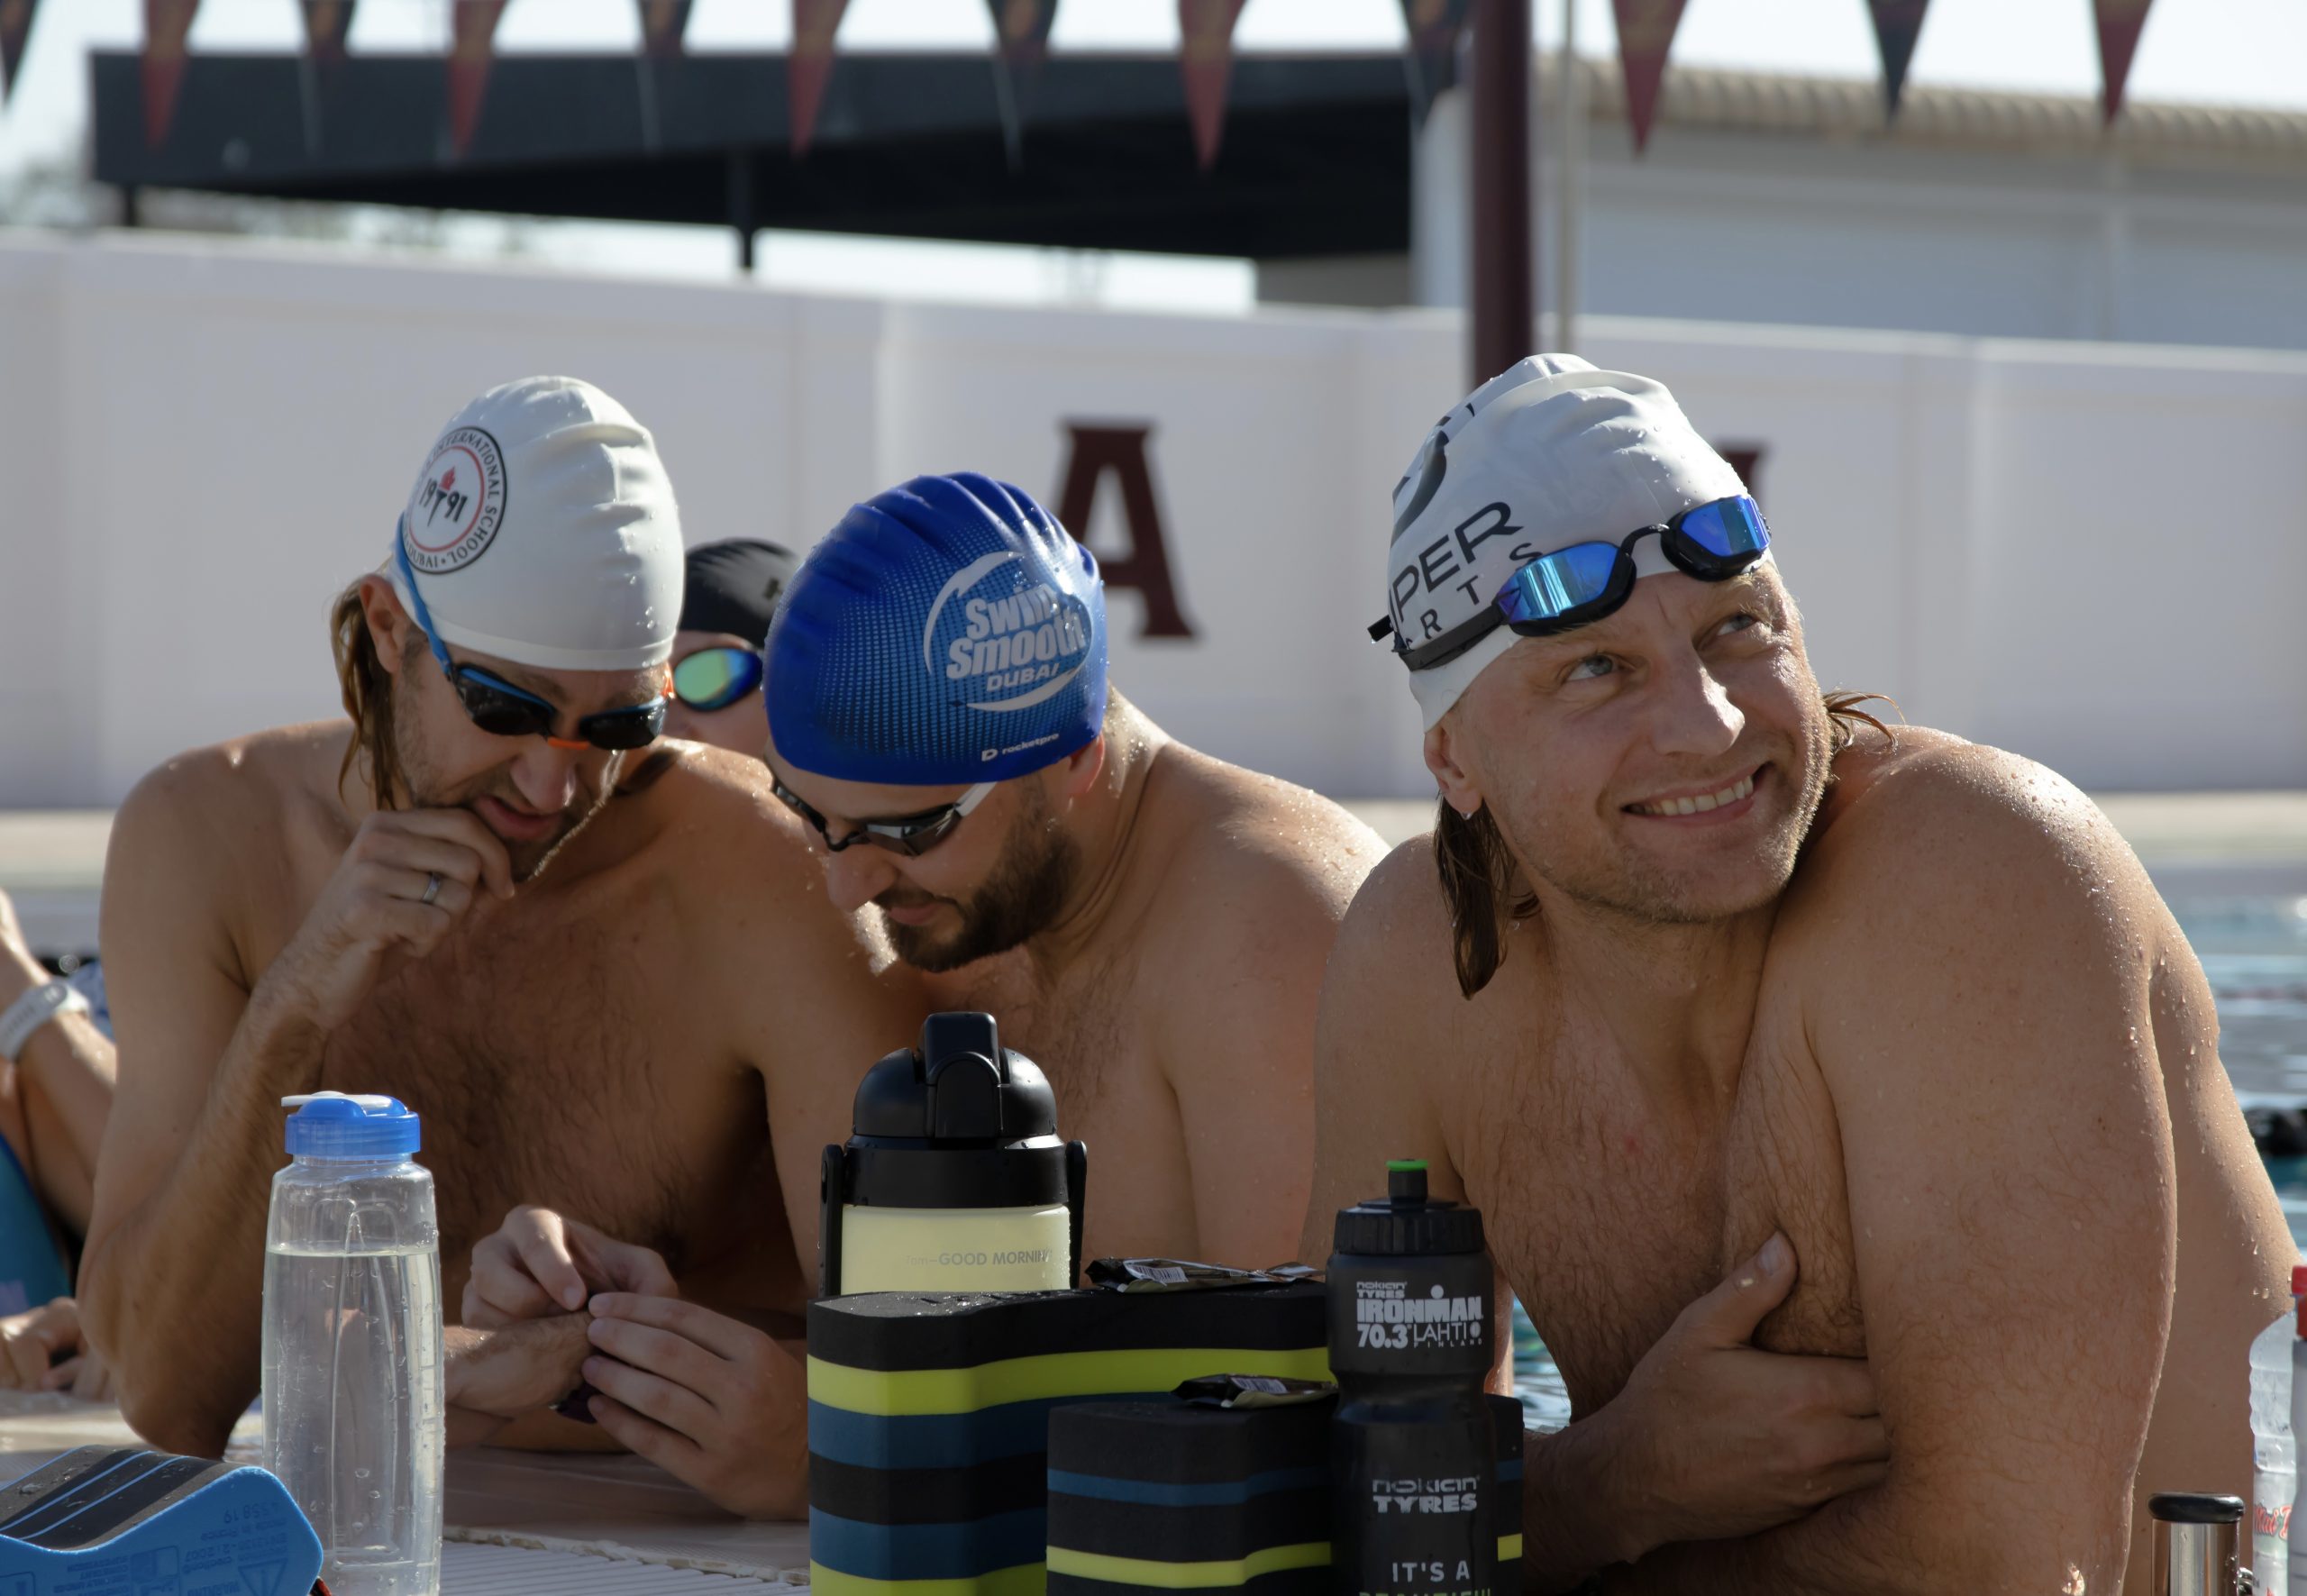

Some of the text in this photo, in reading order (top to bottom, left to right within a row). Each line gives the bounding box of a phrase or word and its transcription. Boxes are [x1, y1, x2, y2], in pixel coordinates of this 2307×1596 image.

[447, 505, 497, 564] SCHOOL
[1056, 419, 1200, 642] A
[407, 545, 439, 569] DUBAI
[965, 582, 1061, 641] Swim
[946, 606, 1086, 679] Smooth
[986, 662, 1061, 693] DUBAI
[1356, 1289, 1405, 1299] TYRES
[1356, 1295, 1482, 1324] IRONMAN
[1356, 1322, 1467, 1349] 70.3 LAHTI
[1372, 1492, 1478, 1514] TYRES
[1391, 1559, 1471, 1583] IT'S A
